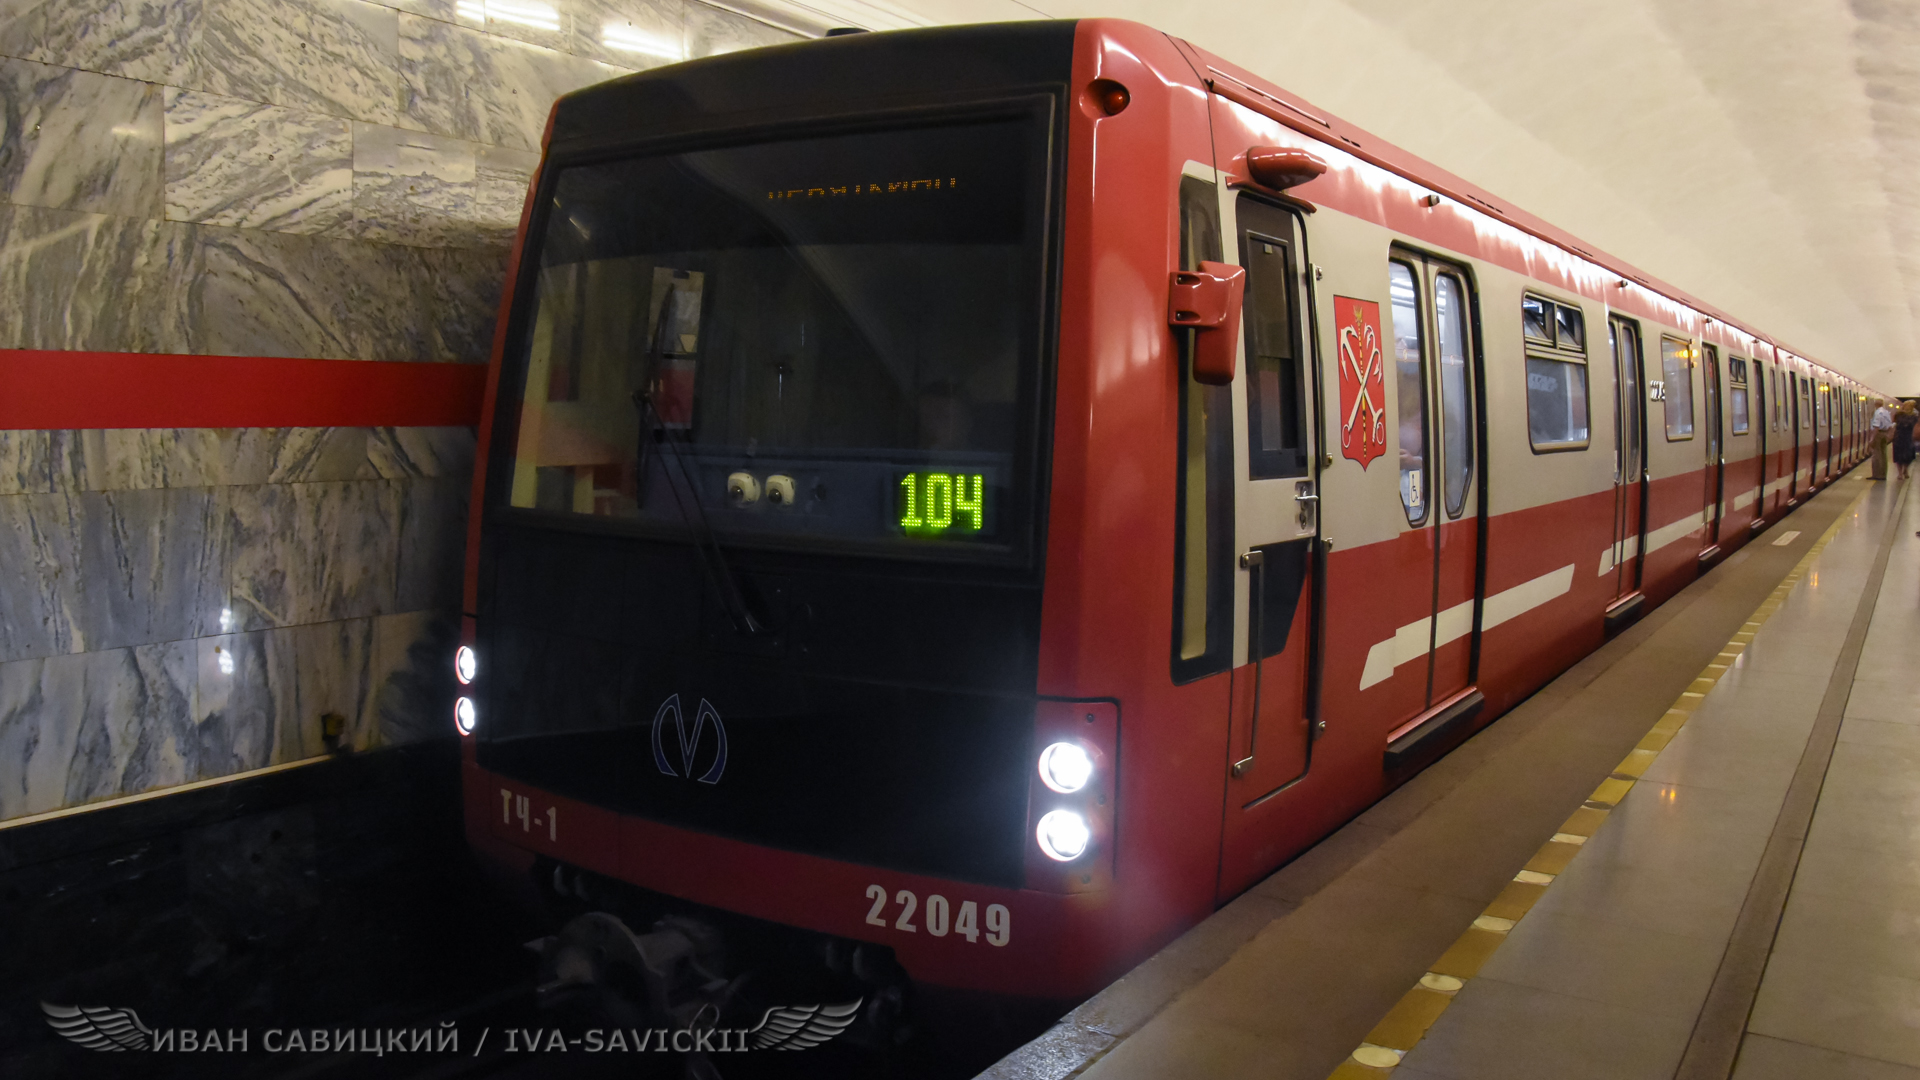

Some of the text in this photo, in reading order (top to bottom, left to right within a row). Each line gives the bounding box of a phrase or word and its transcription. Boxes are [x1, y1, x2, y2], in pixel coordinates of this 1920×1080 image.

[900, 472, 983, 529] 104
[500, 788, 557, 842] ТЧ-1
[866, 884, 1010, 947] 22049
